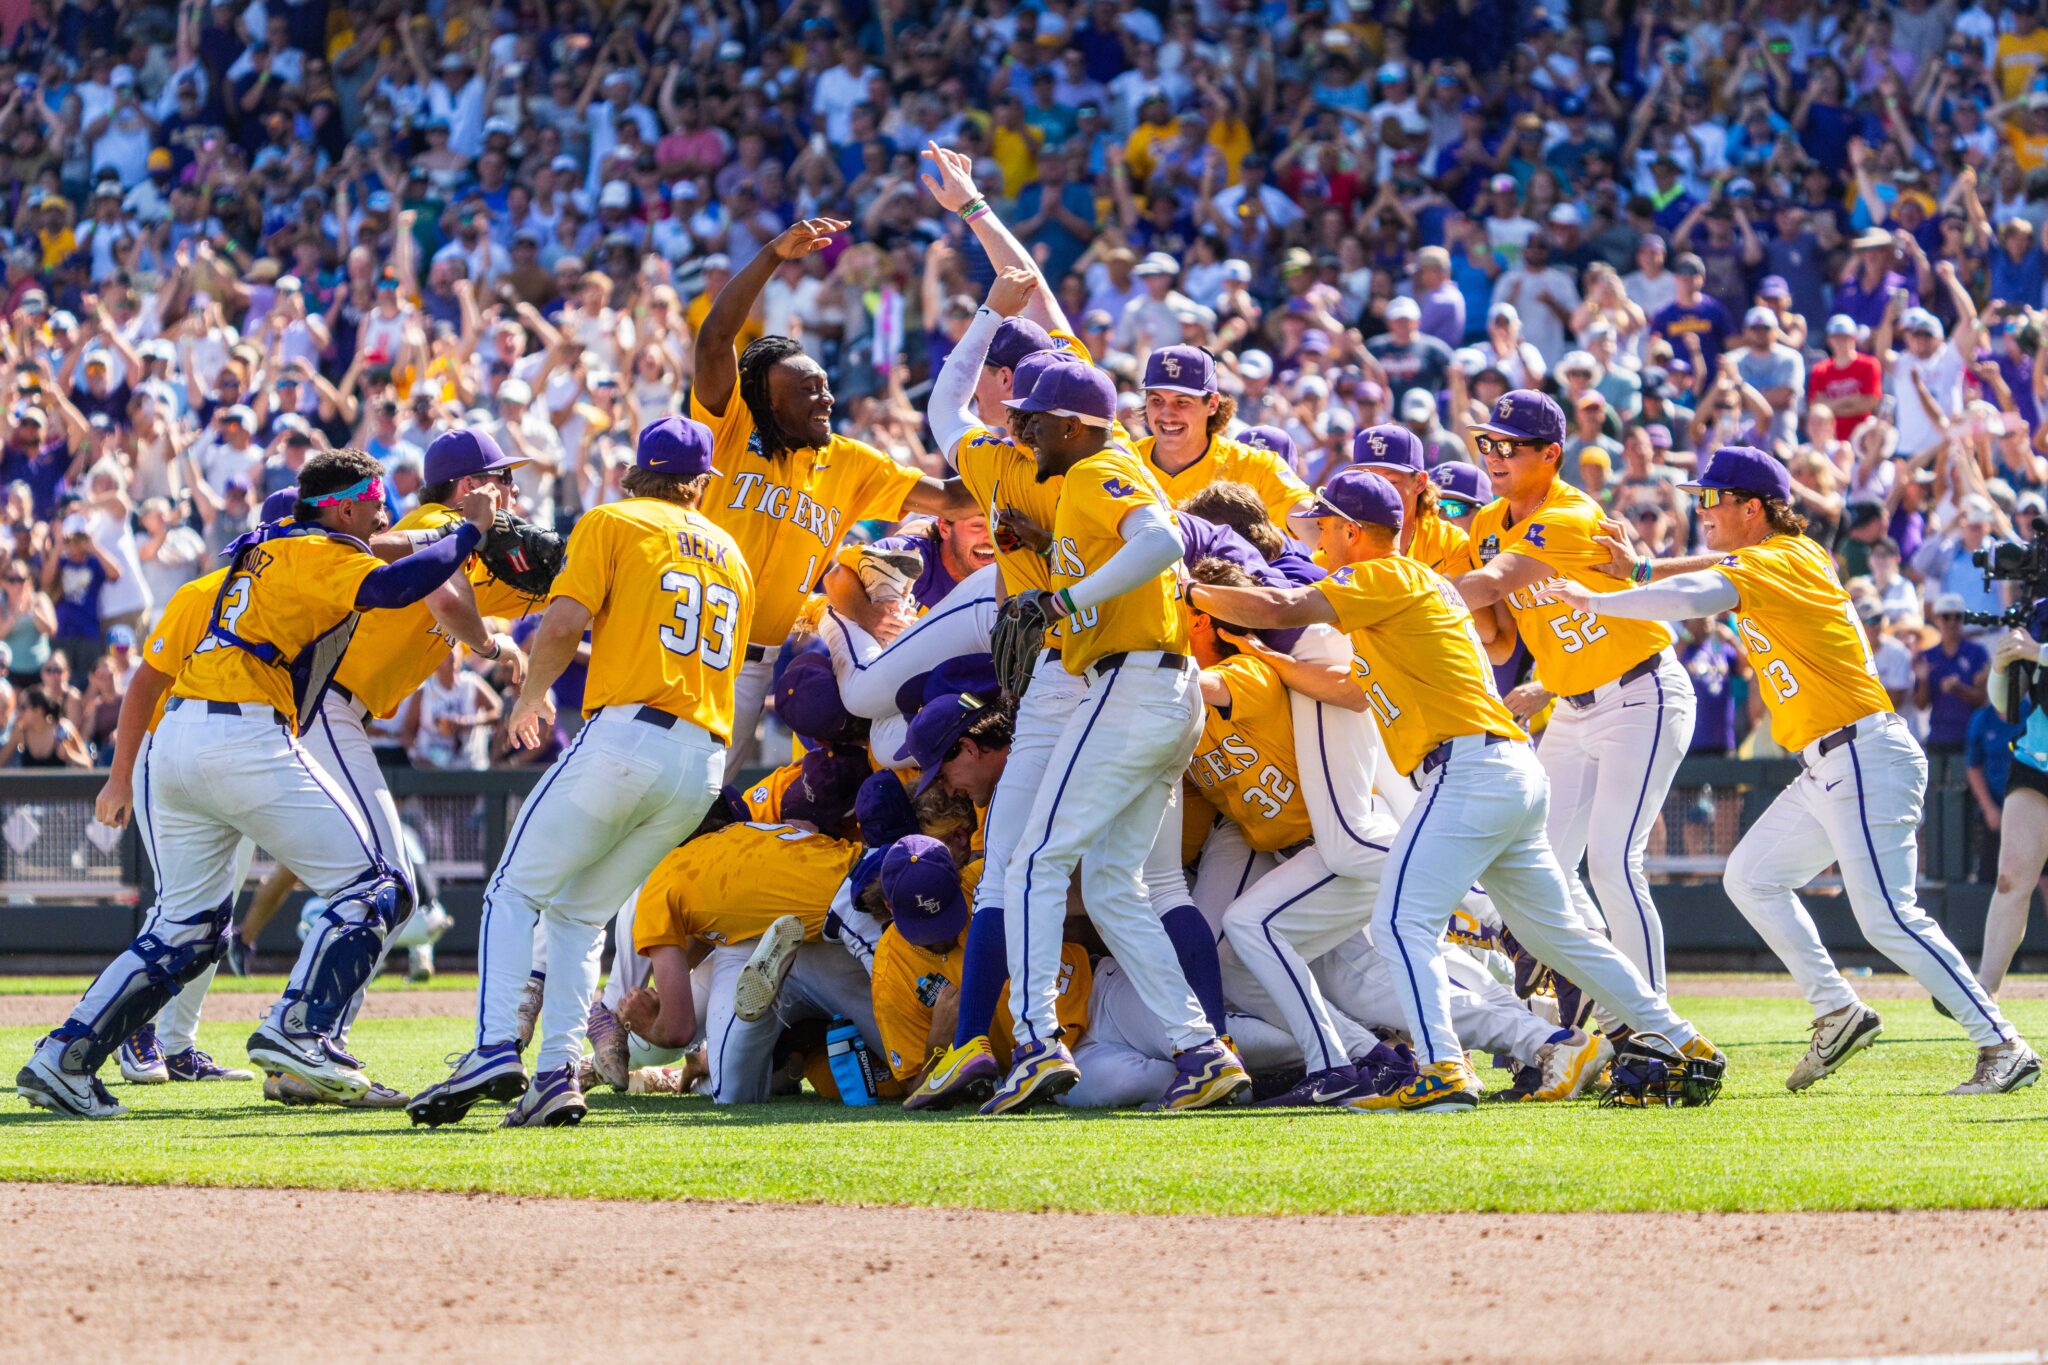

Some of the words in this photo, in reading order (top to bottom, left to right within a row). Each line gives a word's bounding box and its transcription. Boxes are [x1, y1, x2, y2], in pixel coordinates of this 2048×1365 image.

[1161, 351, 1182, 378] LSU
[1367, 431, 1388, 456] LSU
[728, 472, 841, 548] TIGERS
[677, 531, 728, 570] BECK
[798, 555, 816, 593] 1
[194, 575, 252, 654] 3
[659, 570, 739, 671] 33
[1548, 609, 1608, 653] 52
[1762, 658, 1799, 704] 13
[1365, 681, 1401, 728] 11
[1242, 764, 1296, 819] 32
[915, 894, 940, 914] LSU
